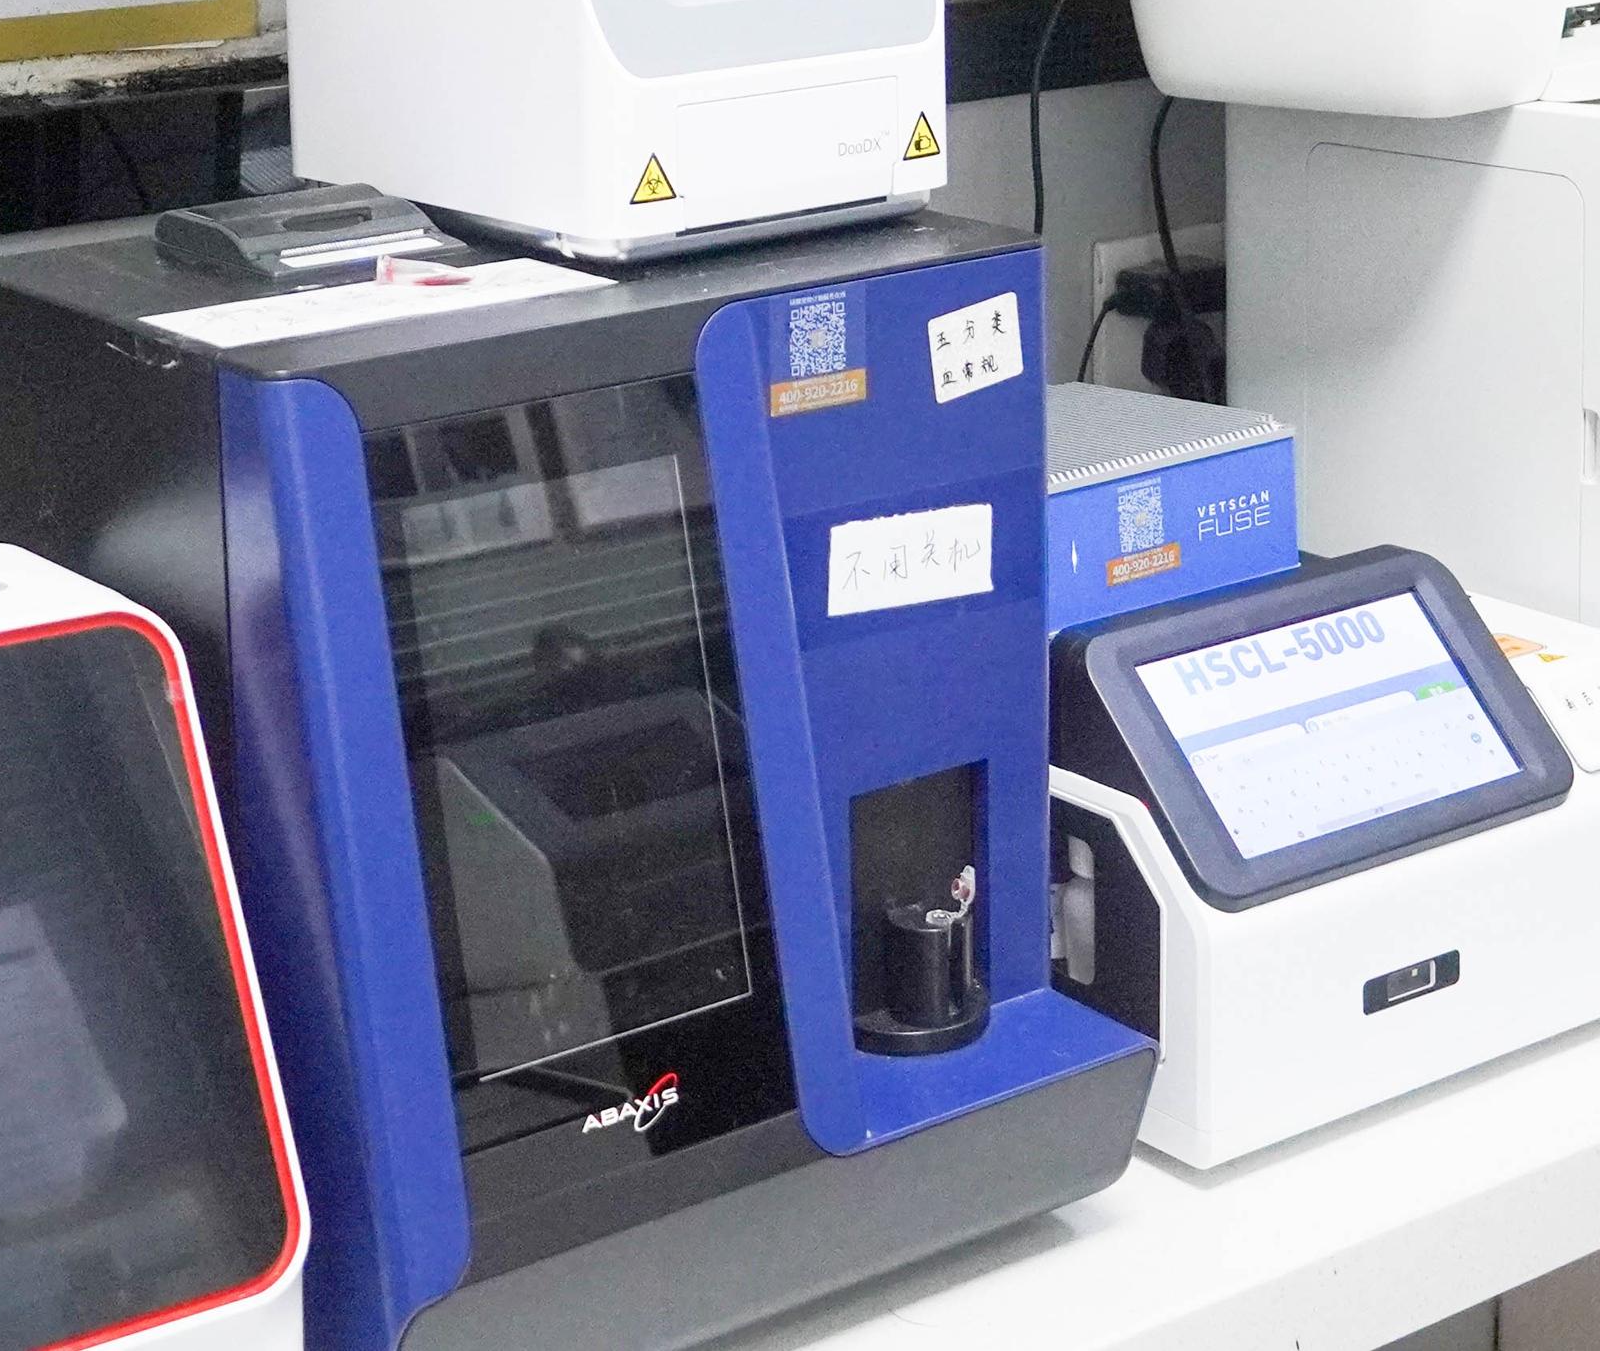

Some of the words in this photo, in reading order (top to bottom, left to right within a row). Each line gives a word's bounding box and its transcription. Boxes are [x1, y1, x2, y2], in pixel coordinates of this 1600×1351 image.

[778, 378, 858, 405] 400-920-2216
[1197, 490, 1270, 518] VETSCAN
[1198, 505, 1271, 541] FUSE
[1112, 551, 1175, 576] 400-920-2216
[1173, 610, 1386, 695] HSCL-5000
[582, 1086, 680, 1134] ABAXIS
